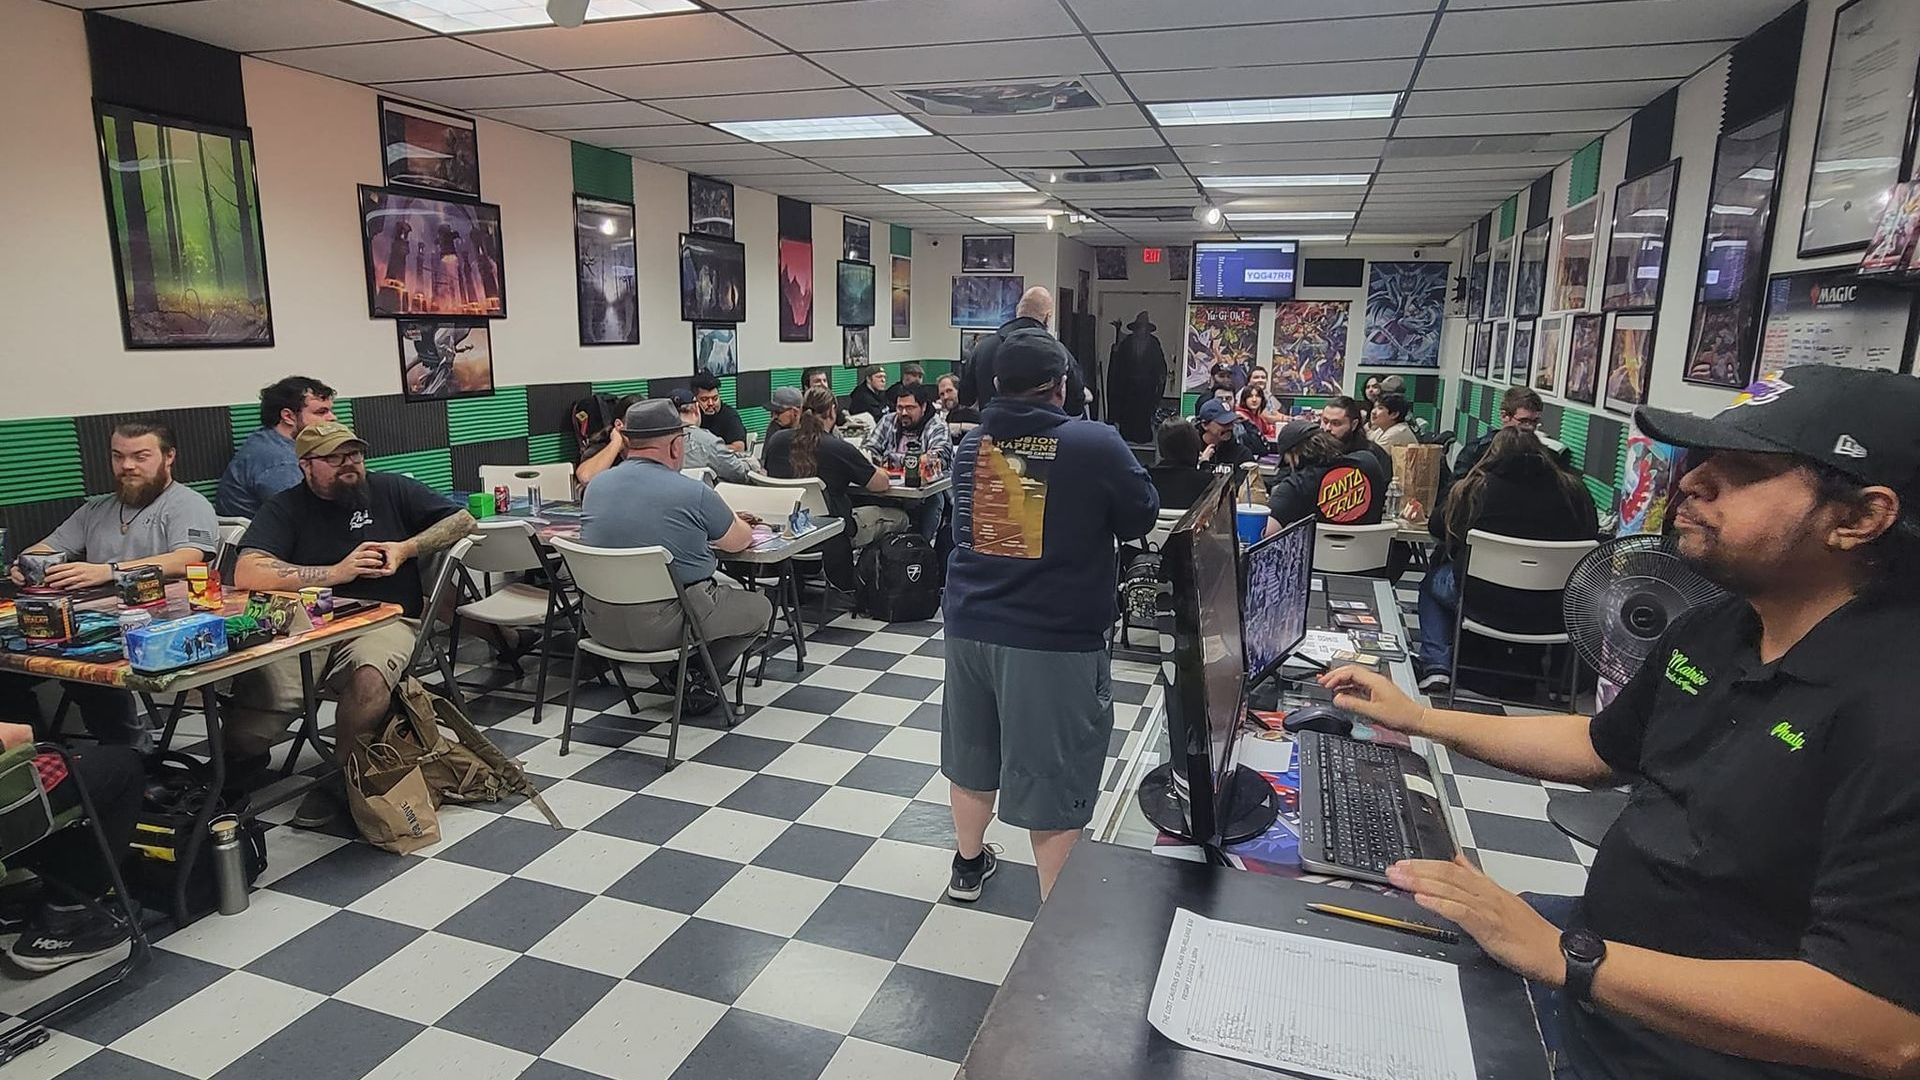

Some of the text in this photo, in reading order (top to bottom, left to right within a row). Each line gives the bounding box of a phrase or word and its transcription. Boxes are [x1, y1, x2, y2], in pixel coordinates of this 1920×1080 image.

[1144, 248, 1161, 263] EXIT
[1817, 286, 1857, 303] MAGIC
[1317, 468, 1363, 506] SANTA
[1326, 486, 1365, 518] CRUZ
[400, 801, 417, 824] ABOVE
